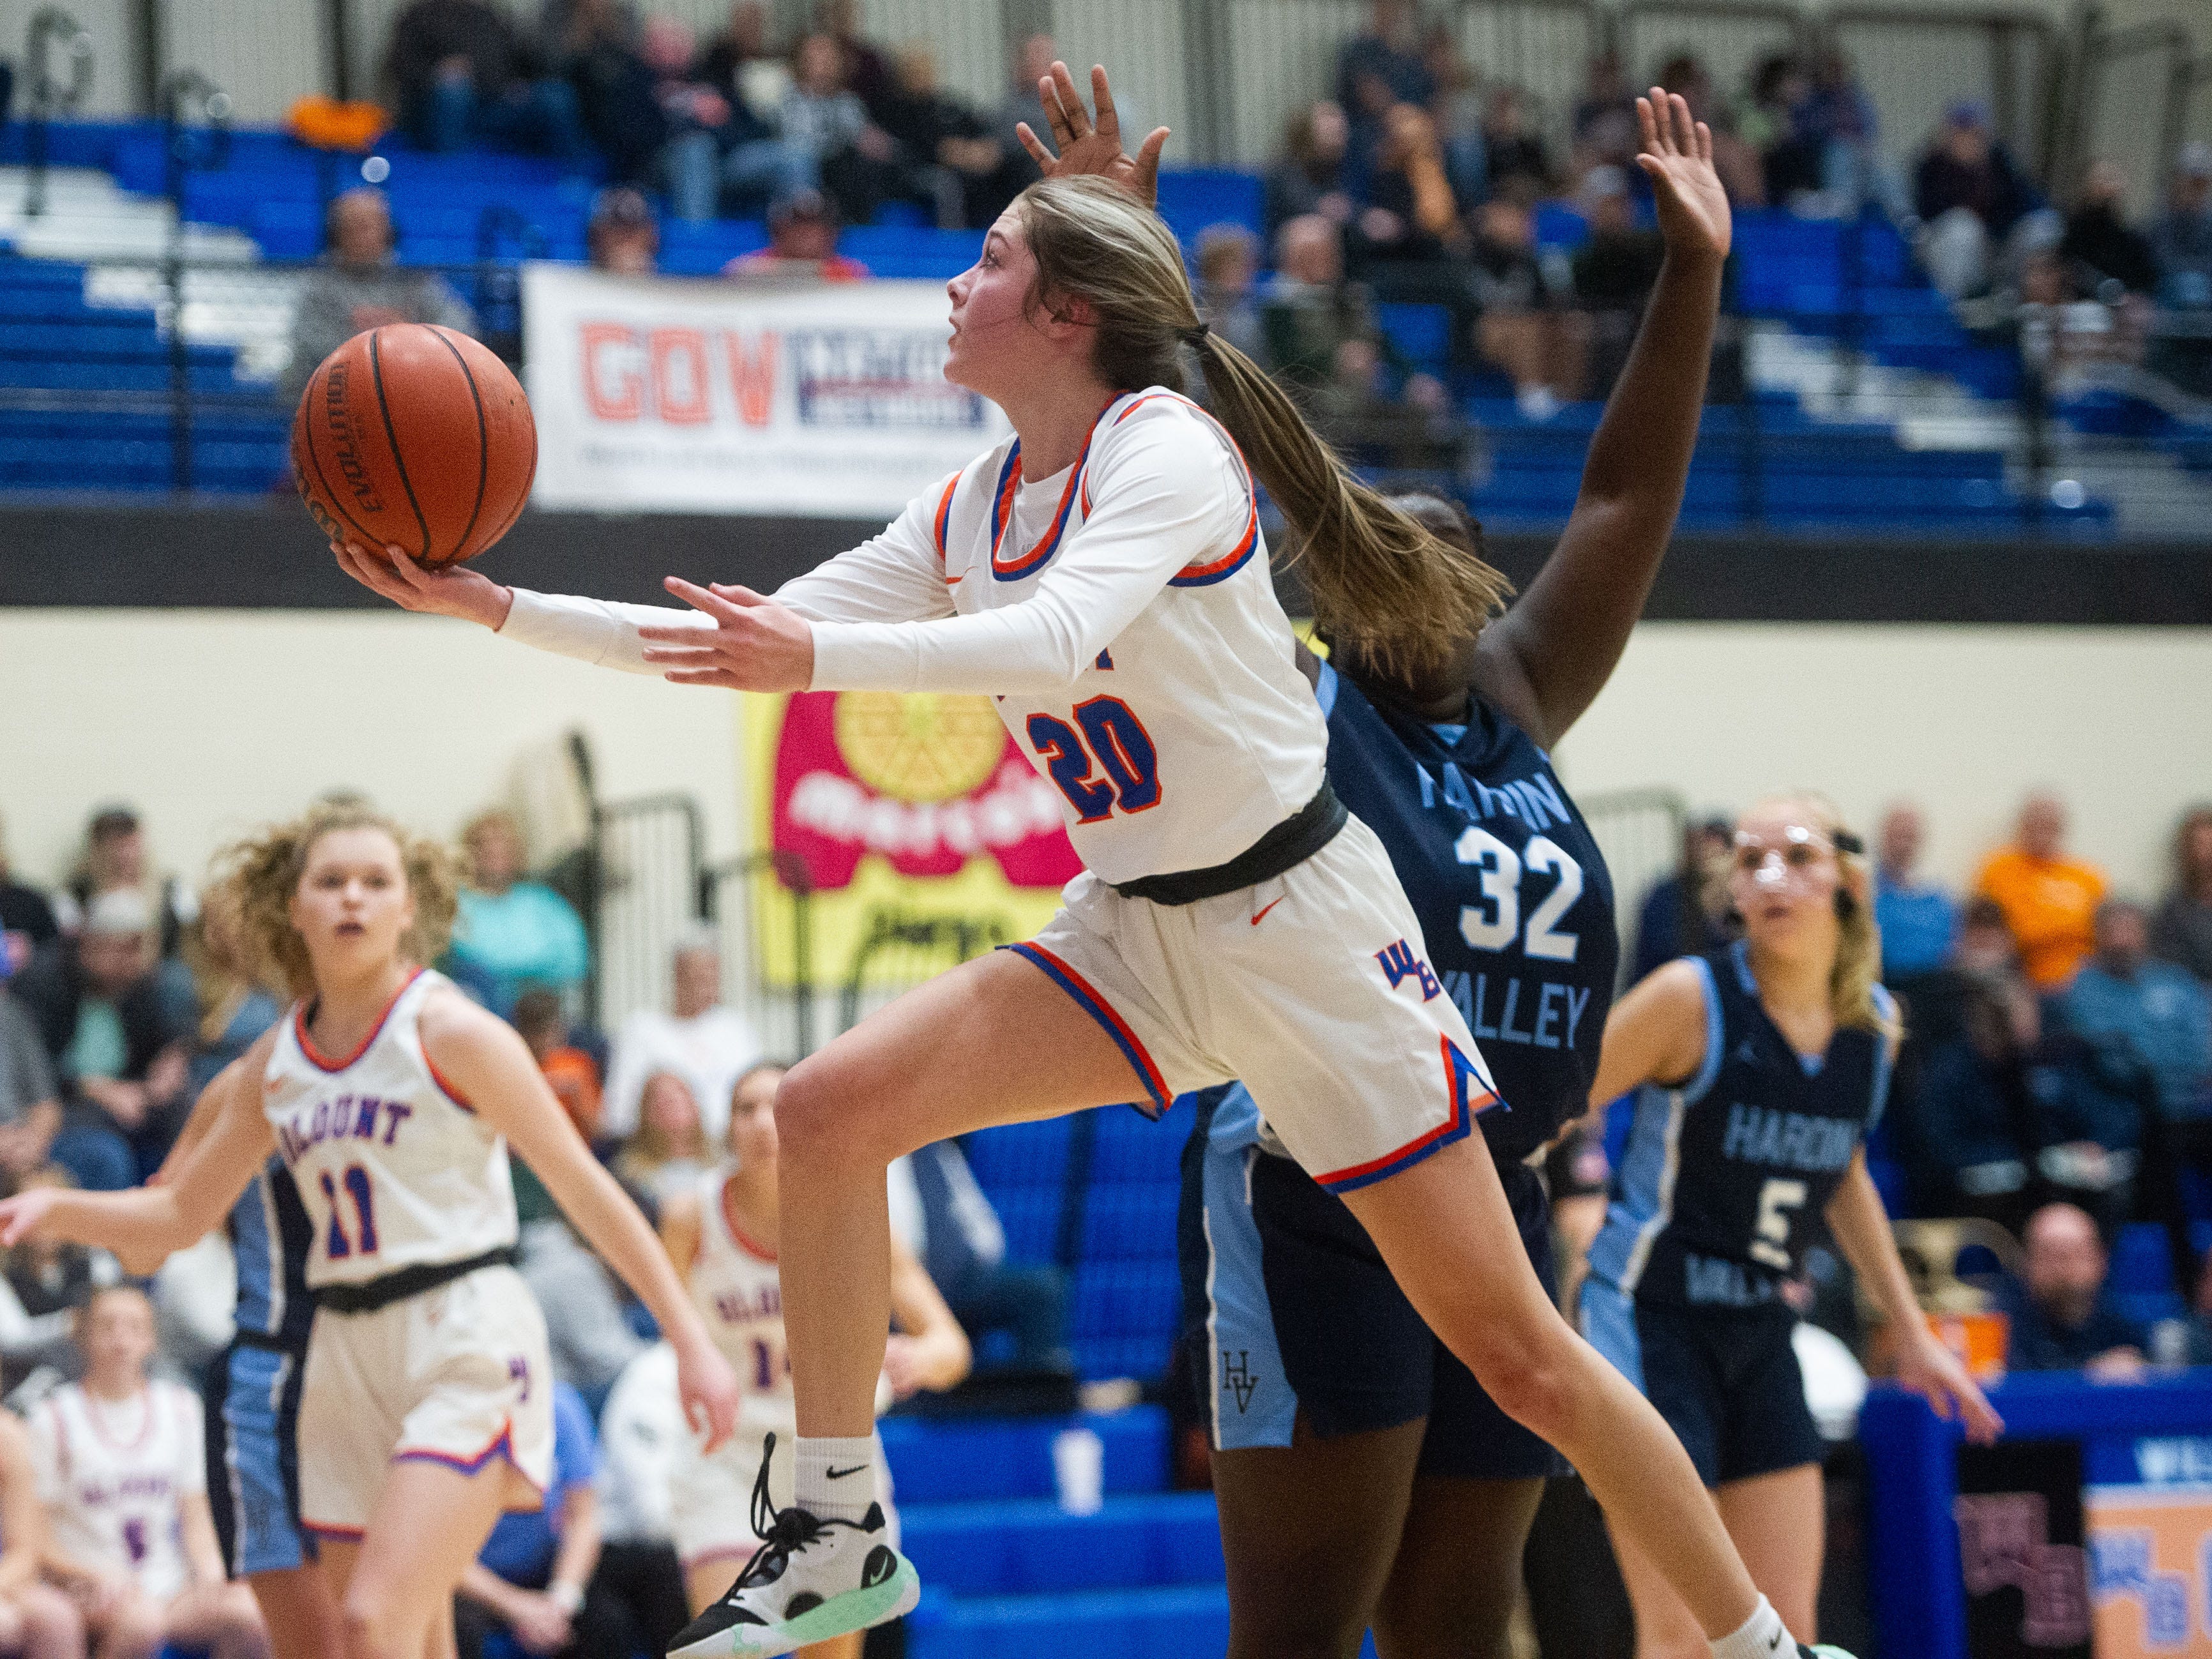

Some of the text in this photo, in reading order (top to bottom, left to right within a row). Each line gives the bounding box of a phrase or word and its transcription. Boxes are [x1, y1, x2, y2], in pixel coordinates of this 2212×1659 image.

[580, 321, 778, 427] GOV
[1026, 693, 1162, 824] 20
[1455, 826, 1582, 962] 32
[321, 1163, 377, 1259] 11
[1748, 1178, 1808, 1269] 5
